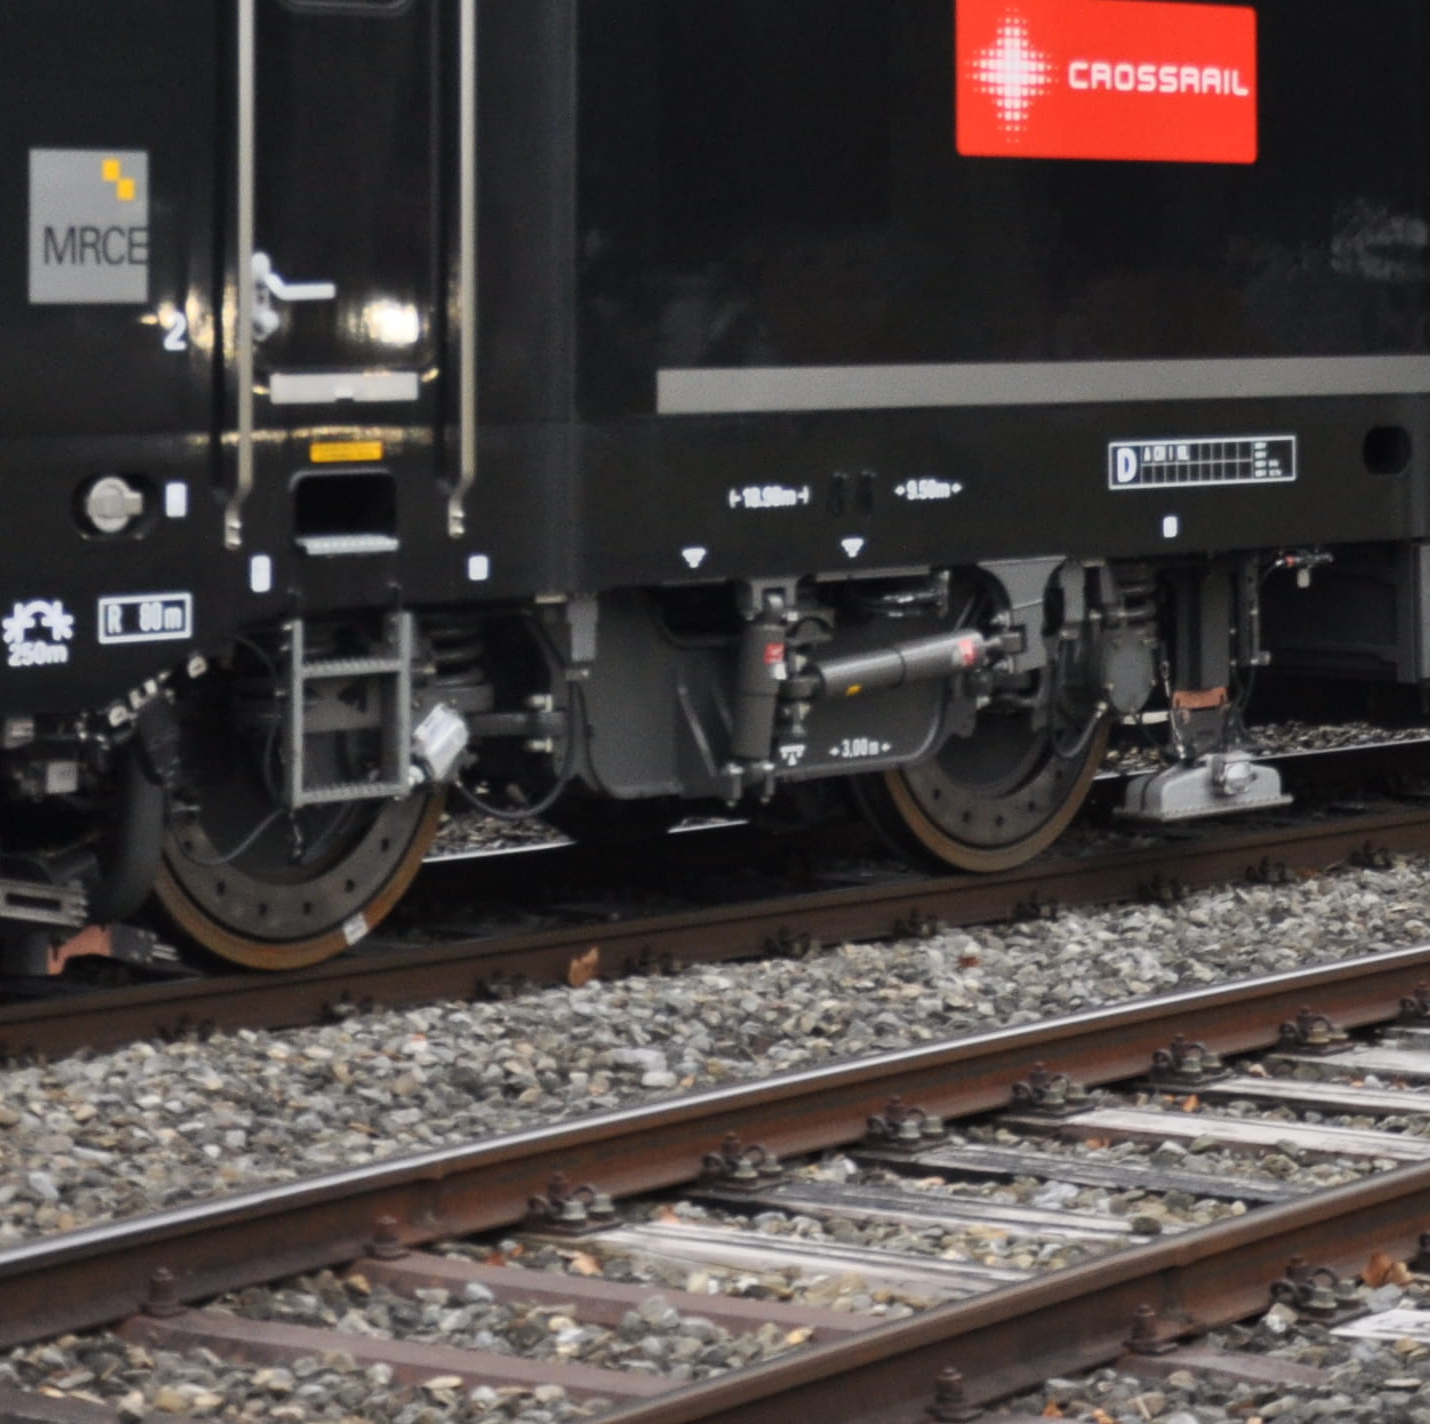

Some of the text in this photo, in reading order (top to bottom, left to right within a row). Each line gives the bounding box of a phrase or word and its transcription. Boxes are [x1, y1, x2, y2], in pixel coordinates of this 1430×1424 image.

[1068, 62, 1249, 96] CROSSRAIL
[43, 226, 148, 265] MRCE
[163, 312, 187, 351] 2
[1116, 447, 1137, 483] D
[107, 604, 122, 635] R
[7, 640, 69, 667] 250m
